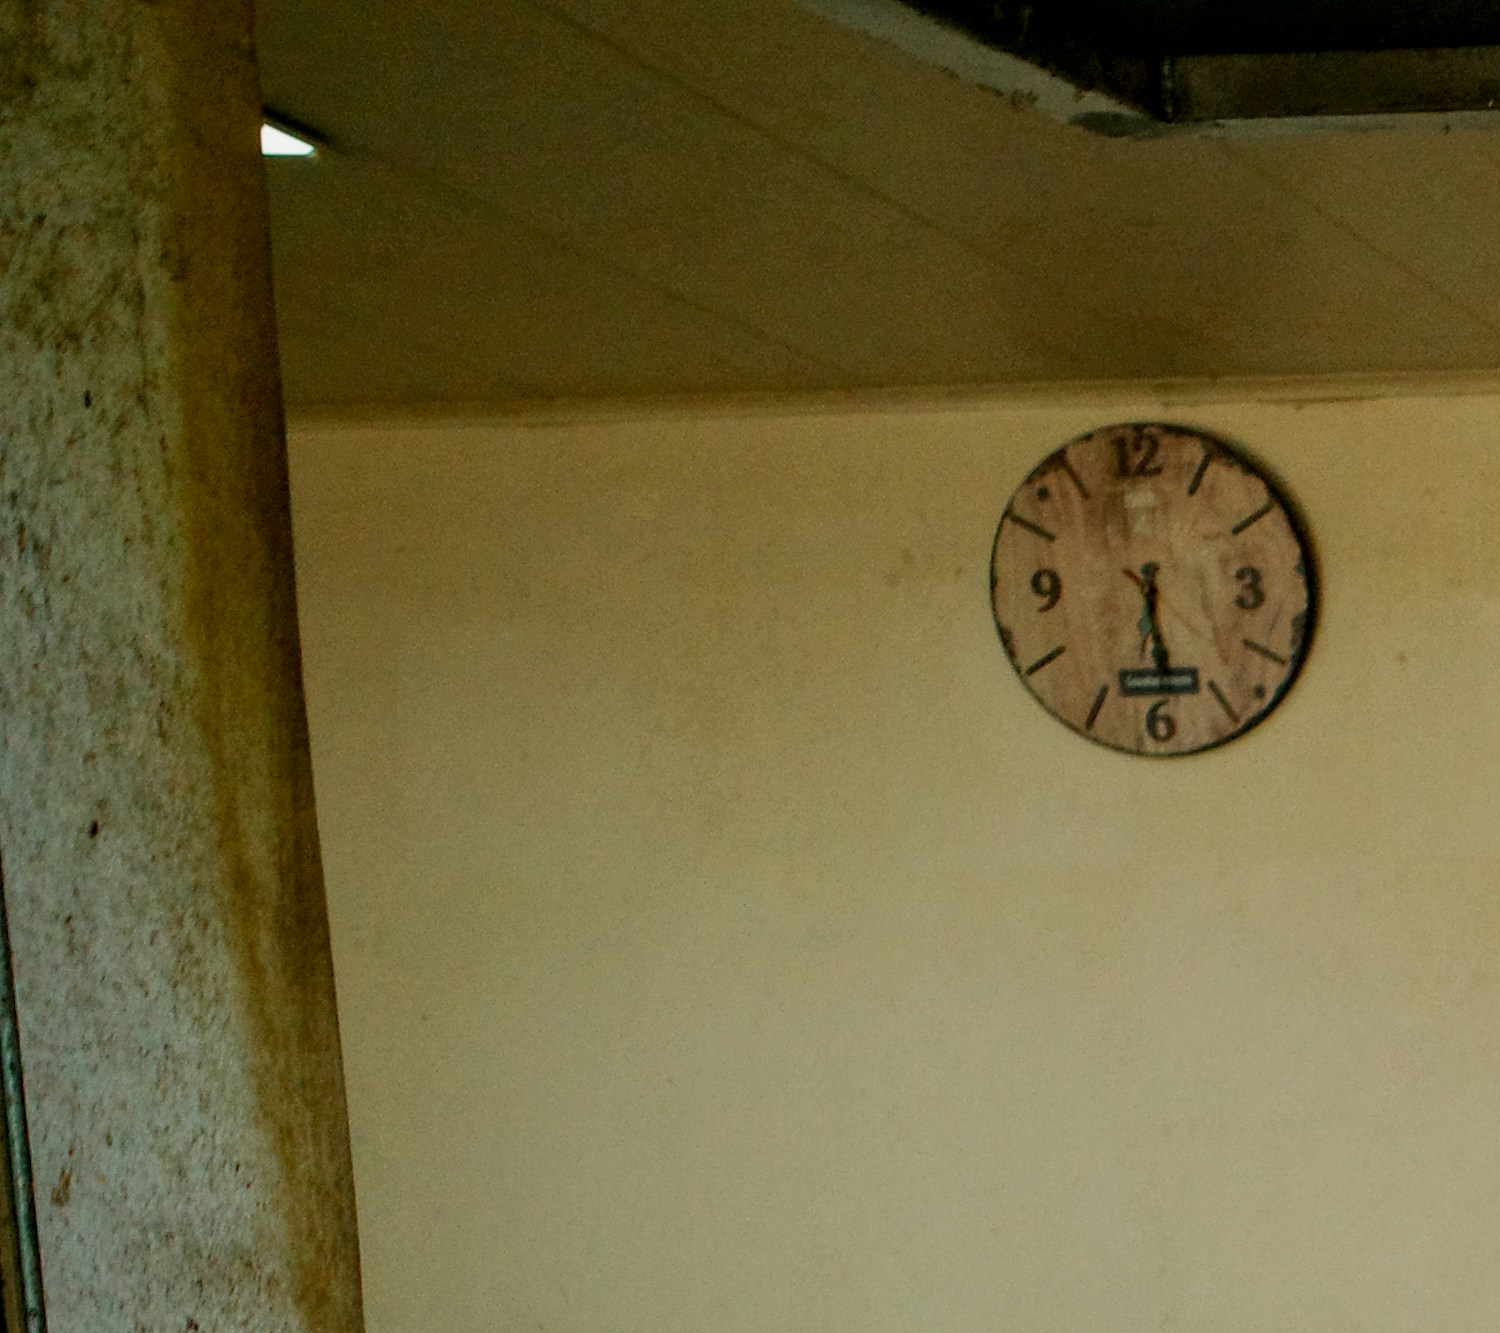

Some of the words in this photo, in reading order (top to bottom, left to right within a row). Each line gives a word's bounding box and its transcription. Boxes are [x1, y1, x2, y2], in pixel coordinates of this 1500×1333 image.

[1110, 430, 1162, 478] 12
[1031, 568, 1062, 612] 9
[1235, 567, 1266, 610] 3
[1145, 699, 1176, 743] 6
